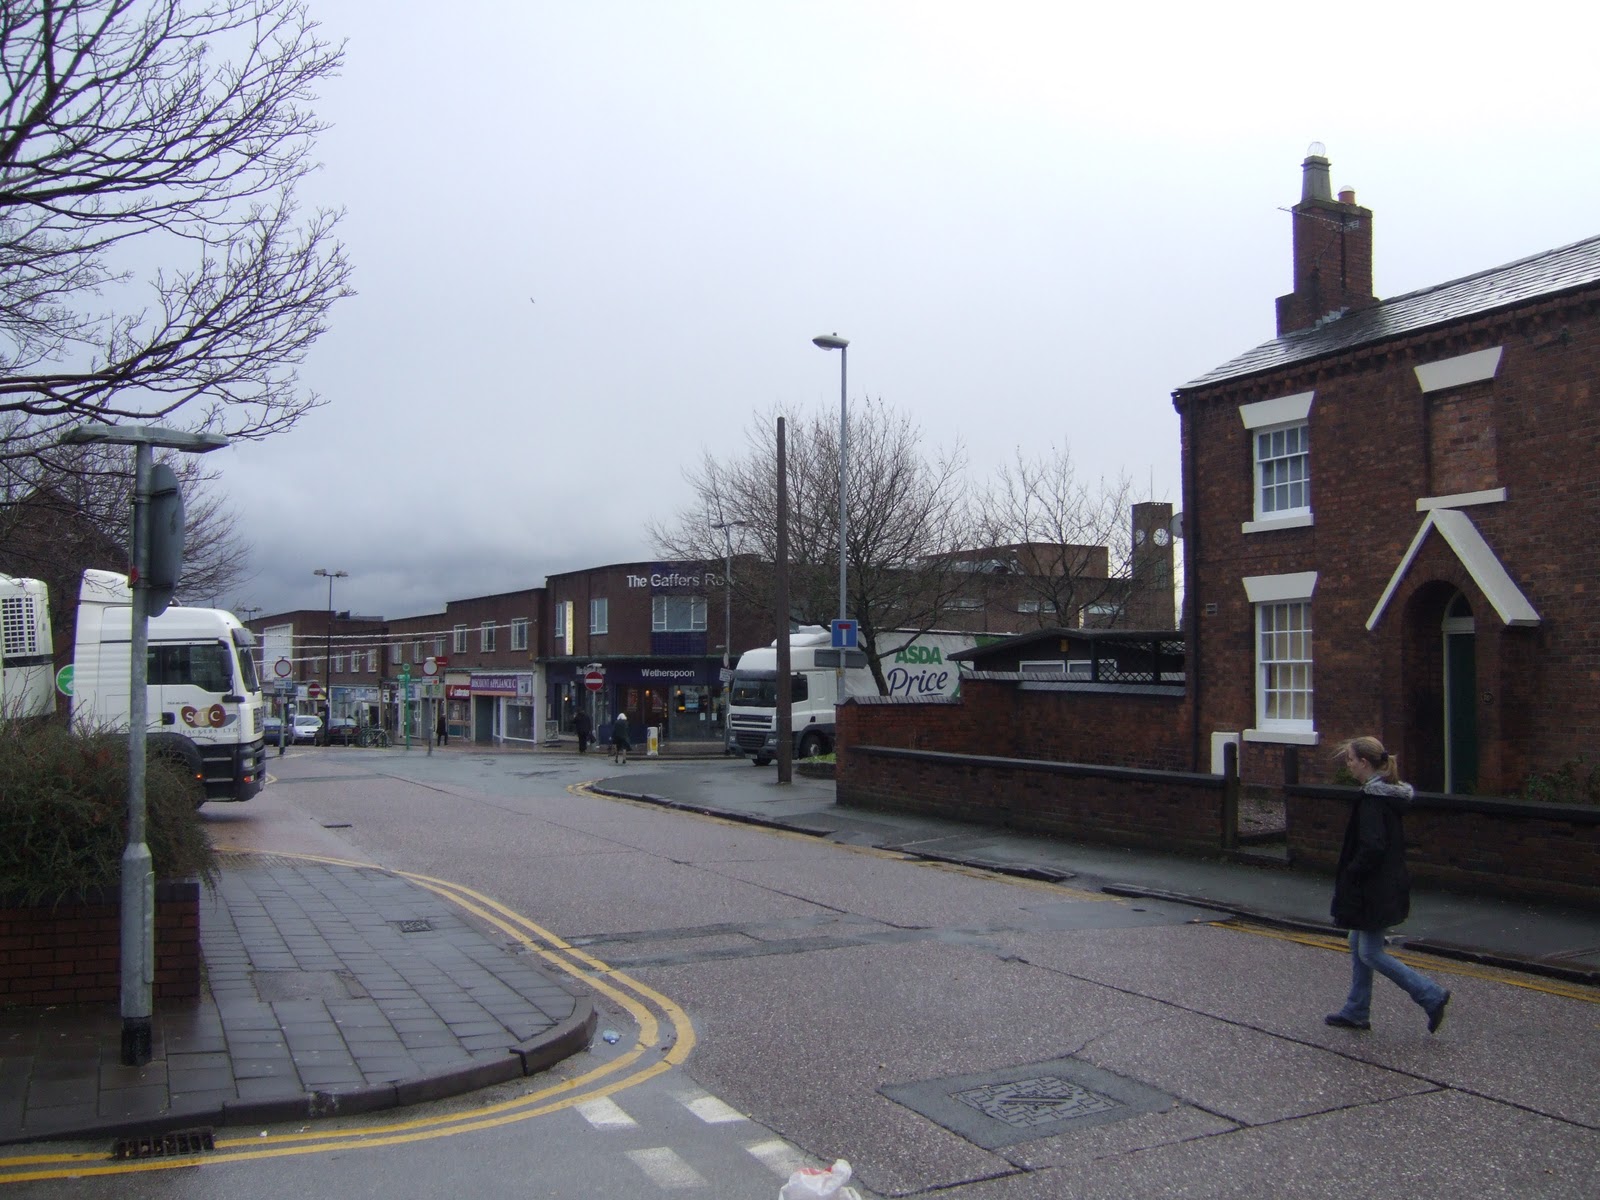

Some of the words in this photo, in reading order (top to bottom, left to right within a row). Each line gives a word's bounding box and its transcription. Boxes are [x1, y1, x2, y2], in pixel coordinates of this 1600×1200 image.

[626, 575, 648, 588] The
[650, 573, 700, 587] Gaffers
[894, 645, 943, 665] ASDA
[641, 668, 695, 678] Wetherspoon
[887, 667, 949, 697] Price
[185, 711, 220, 722] STC
